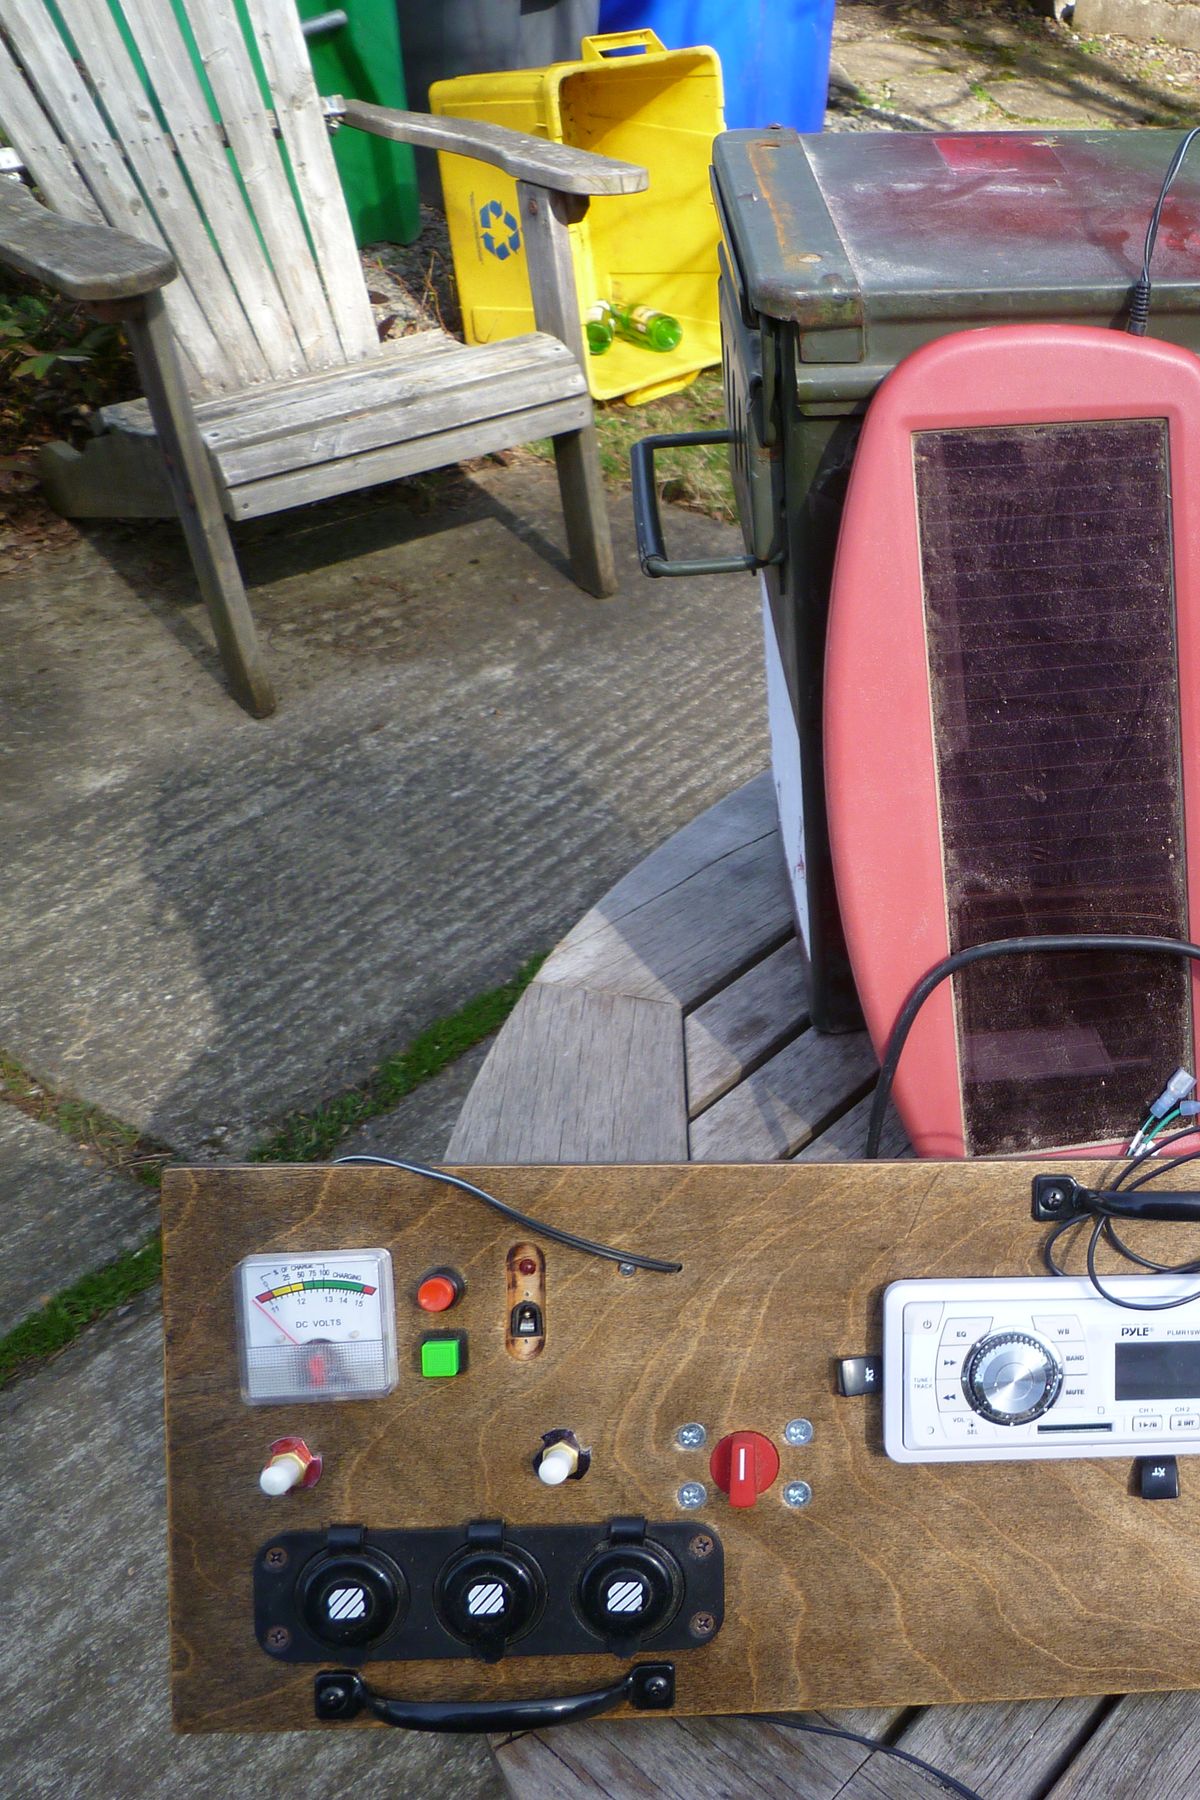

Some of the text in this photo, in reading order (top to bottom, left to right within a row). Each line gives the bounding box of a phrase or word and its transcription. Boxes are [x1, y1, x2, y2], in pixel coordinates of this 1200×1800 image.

[332, 1272, 362, 1281] CHARGING
[313, 1319, 342, 1327] VOLTS
[1121, 1327, 1149, 1336] PYLE
[1065, 1354, 1084, 1362] BAND
[1065, 1388, 1085, 1396] MUTE
